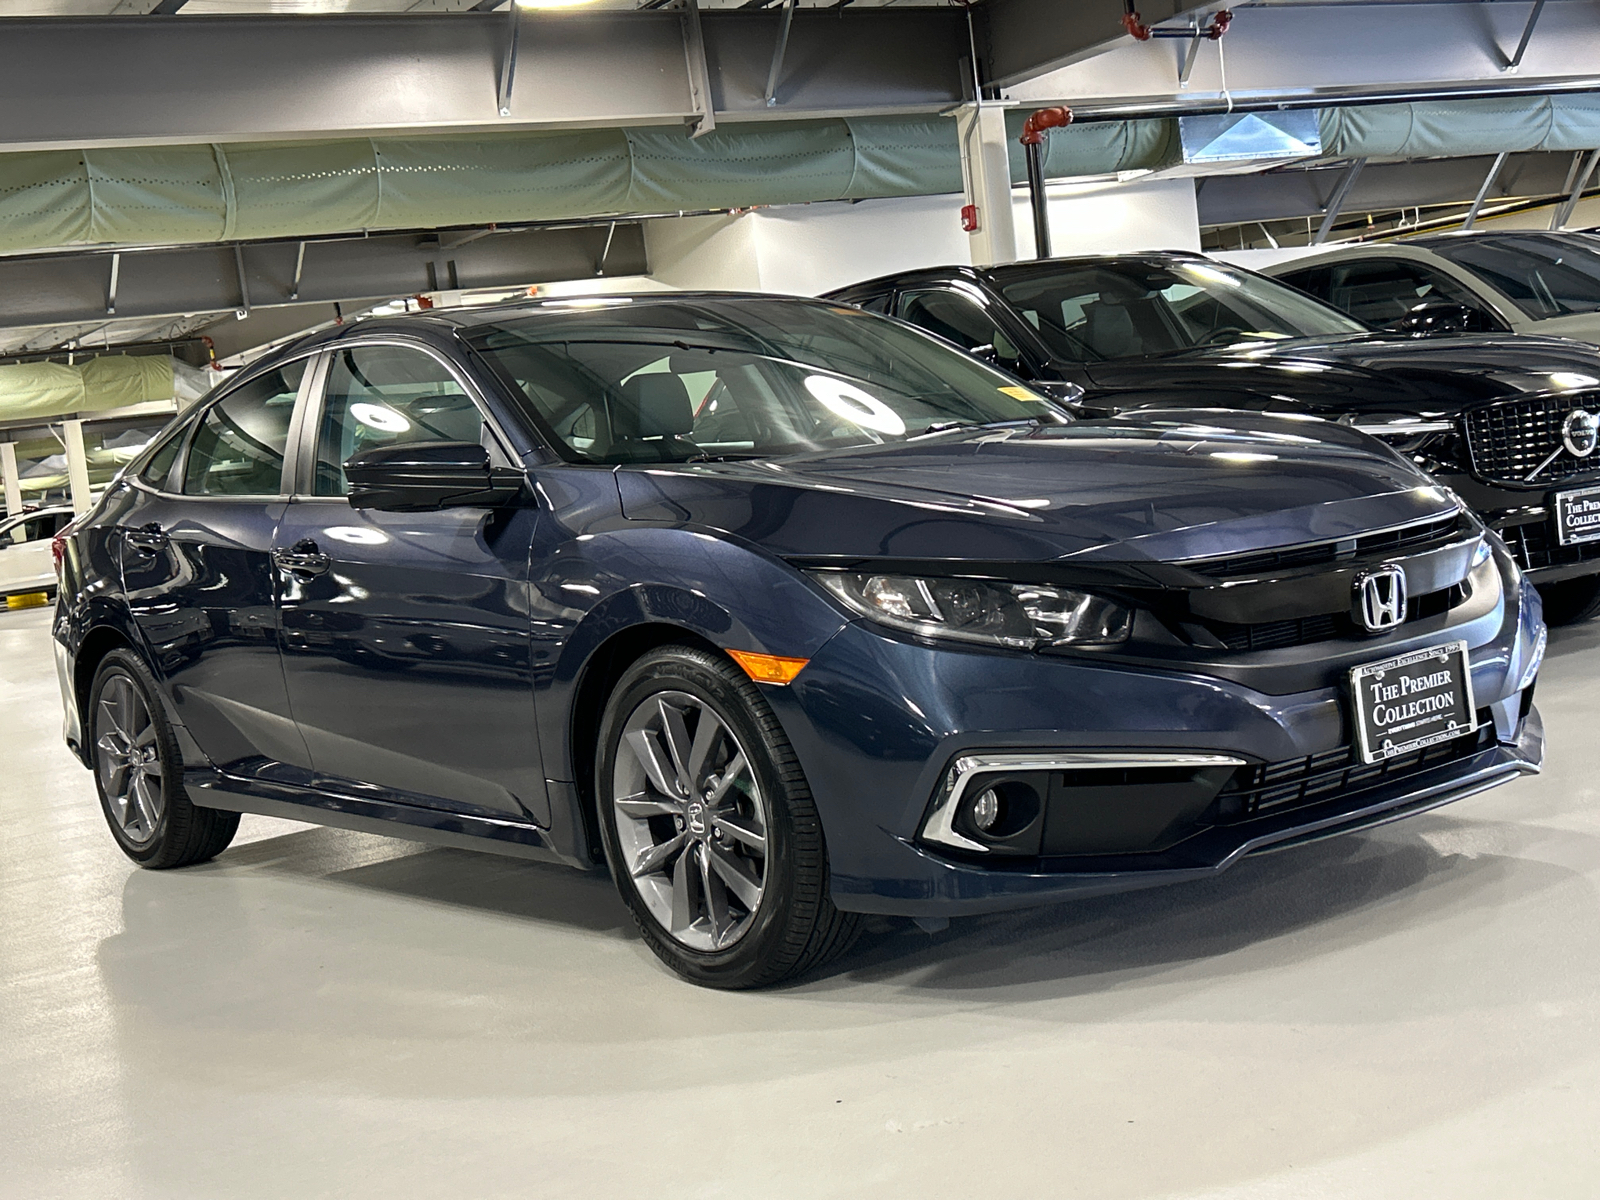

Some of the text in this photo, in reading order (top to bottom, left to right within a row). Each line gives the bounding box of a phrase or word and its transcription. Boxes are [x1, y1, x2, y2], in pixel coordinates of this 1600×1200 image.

[1571, 429, 1595, 437] VOLVO
[1564, 502, 1582, 514] THE
[1370, 670, 1452, 703] THE PREMIER
[1372, 691, 1455, 727] COLLECTION
